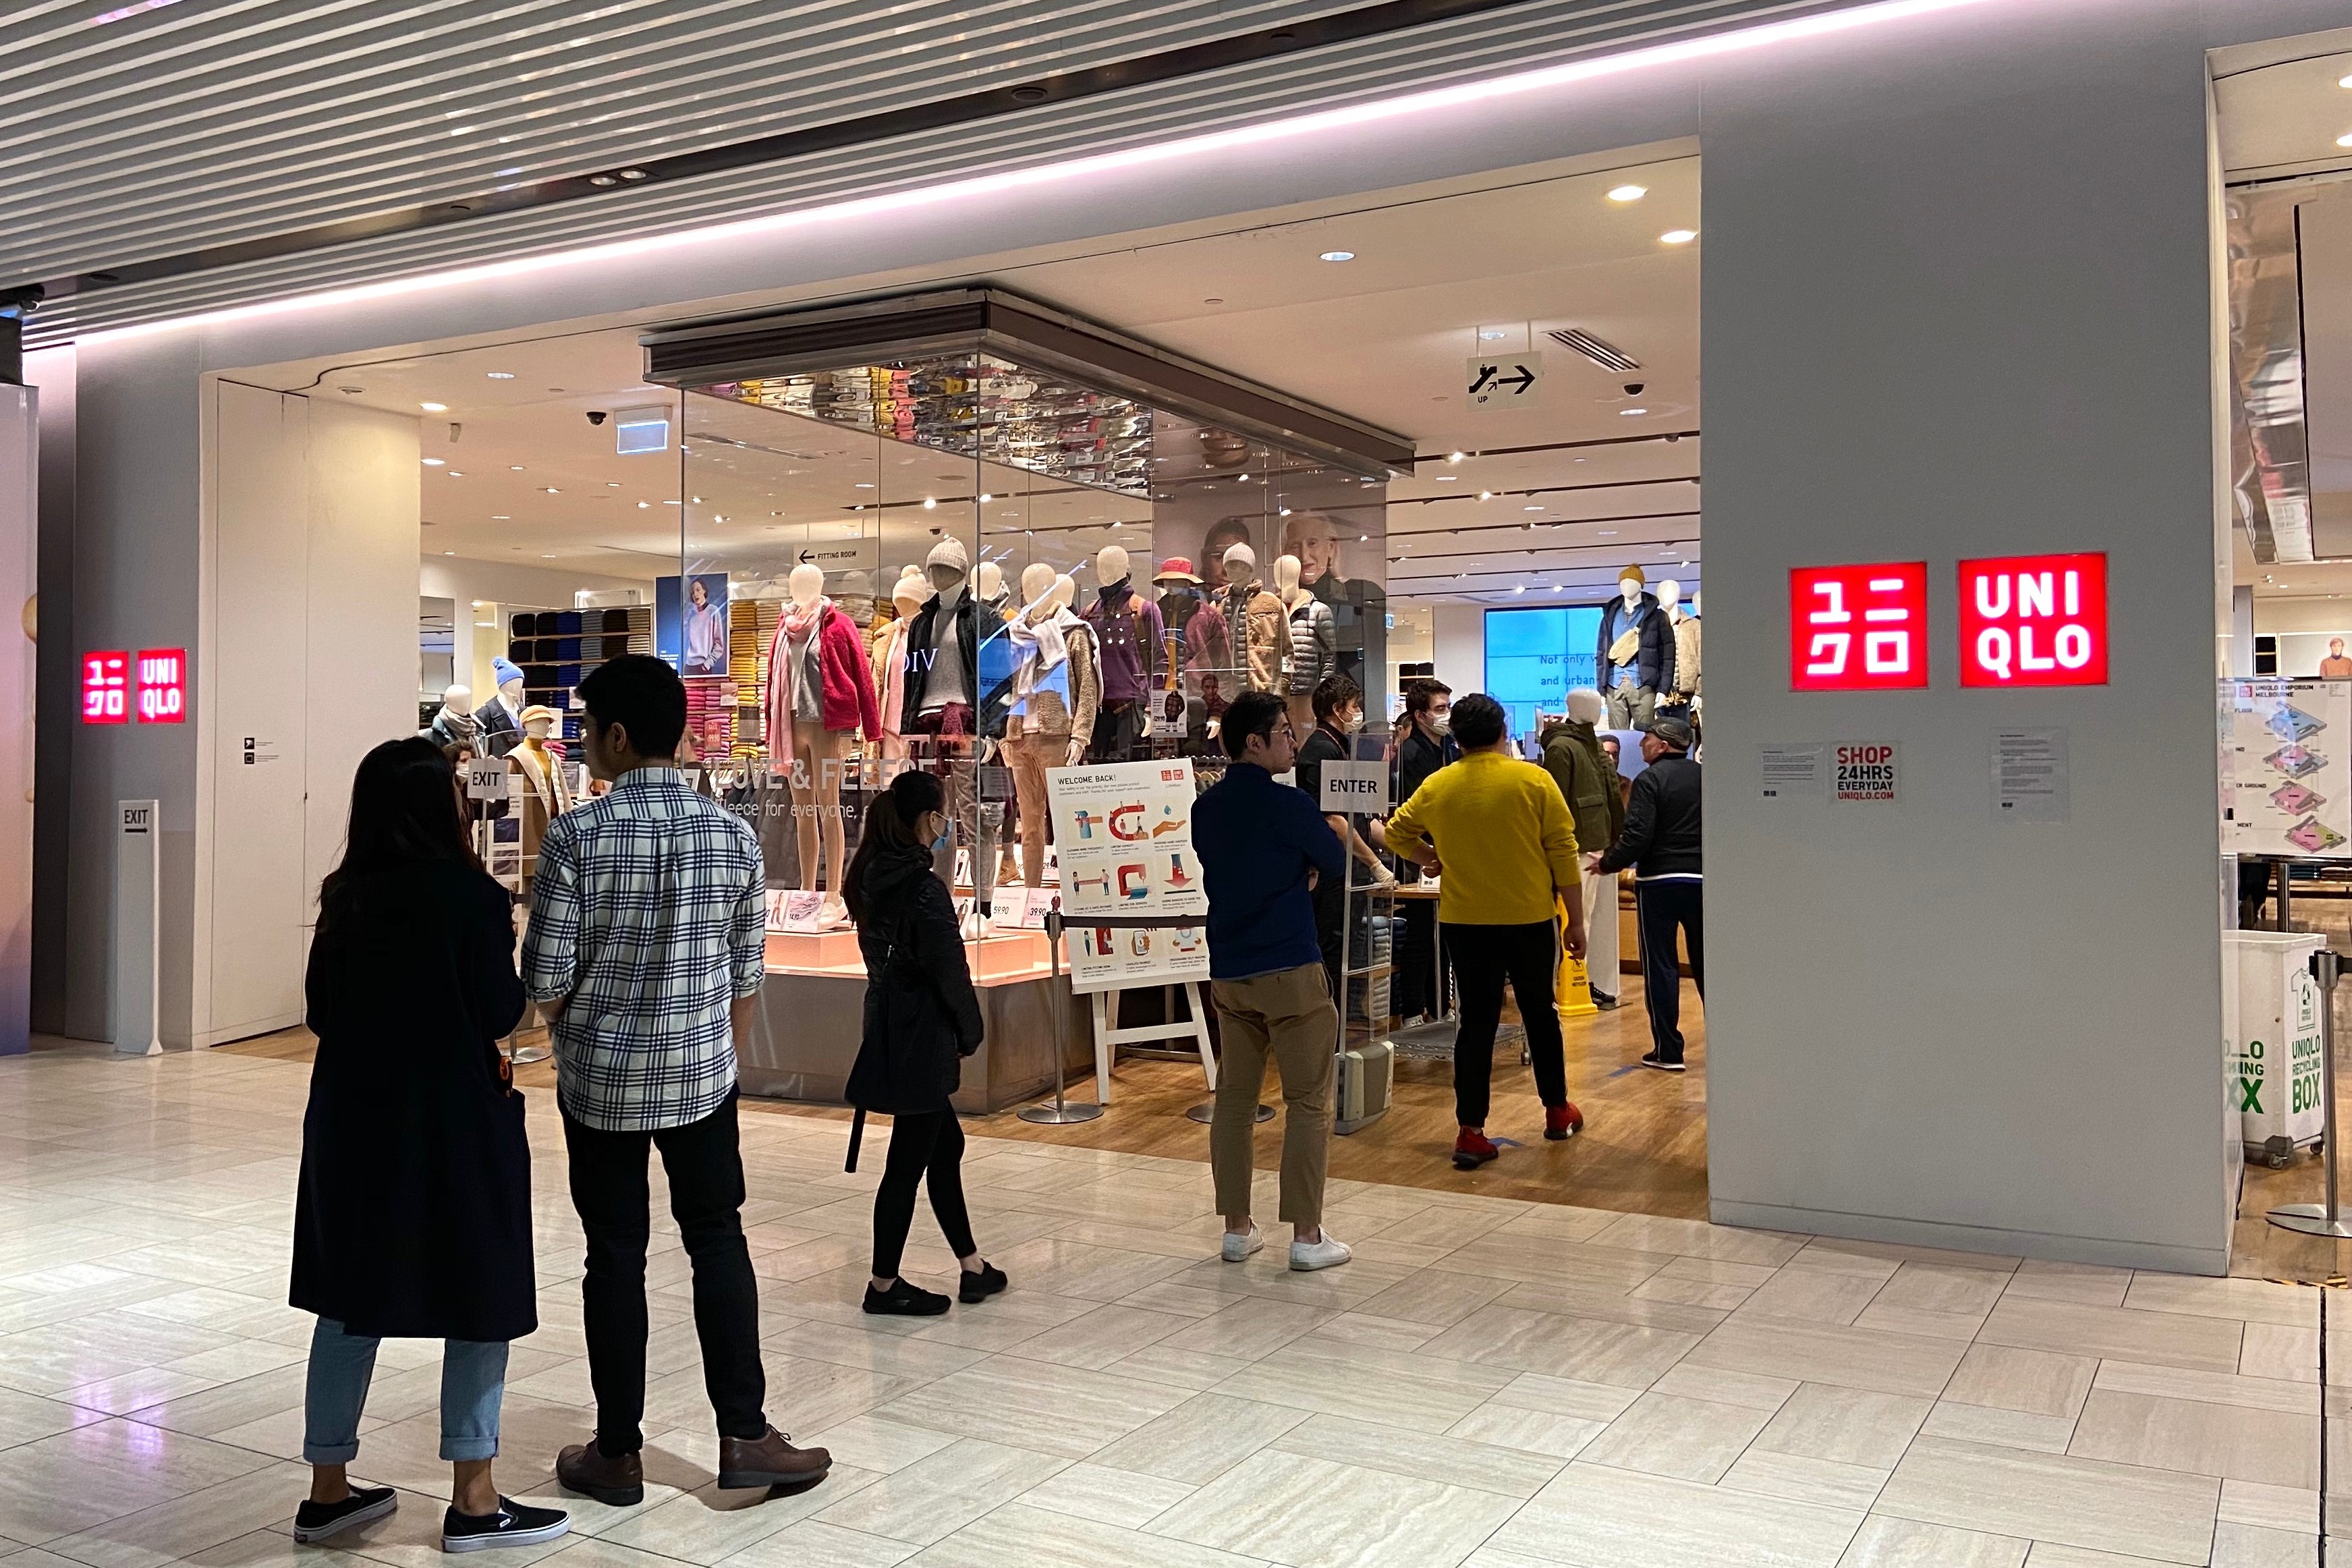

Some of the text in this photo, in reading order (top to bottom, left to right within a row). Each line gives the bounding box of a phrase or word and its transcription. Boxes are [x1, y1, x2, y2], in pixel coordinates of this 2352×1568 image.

[1478, 395, 1488, 403] UP
[818, 552, 839, 560] FITTING
[1976, 571, 2079, 619] UNI
[1977, 624, 2091, 679] QLO
[1540, 655, 1558, 665] Not
[1563, 654, 1585, 666] only
[143, 658, 177, 684] UNI
[1541, 675, 1595, 685] and urban
[143, 688, 180, 719] QLO
[1542, 697, 1559, 706] and
[1837, 746, 1893, 764] SHOP
[472, 771, 501, 787] EXIT
[714, 758, 783, 790] LOVE
[791, 758, 811, 790] &
[1057, 775, 1116, 785] WELCOME BACK!
[1837, 766, 1893, 780] 24HRS
[1330, 779, 1378, 793] ENTER
[1837, 781, 1894, 791] EVERYDAY
[1838, 791, 1894, 802] UNIQLO.COM
[124, 810, 148, 824] EXIT
[765, 800, 785, 816] for
[790, 802, 857, 819] everyone,
[2292, 1034, 2321, 1059] UNIQLO
[2293, 1057, 2321, 1076] RECYCLING
[2293, 1072, 2321, 1115] BOX
